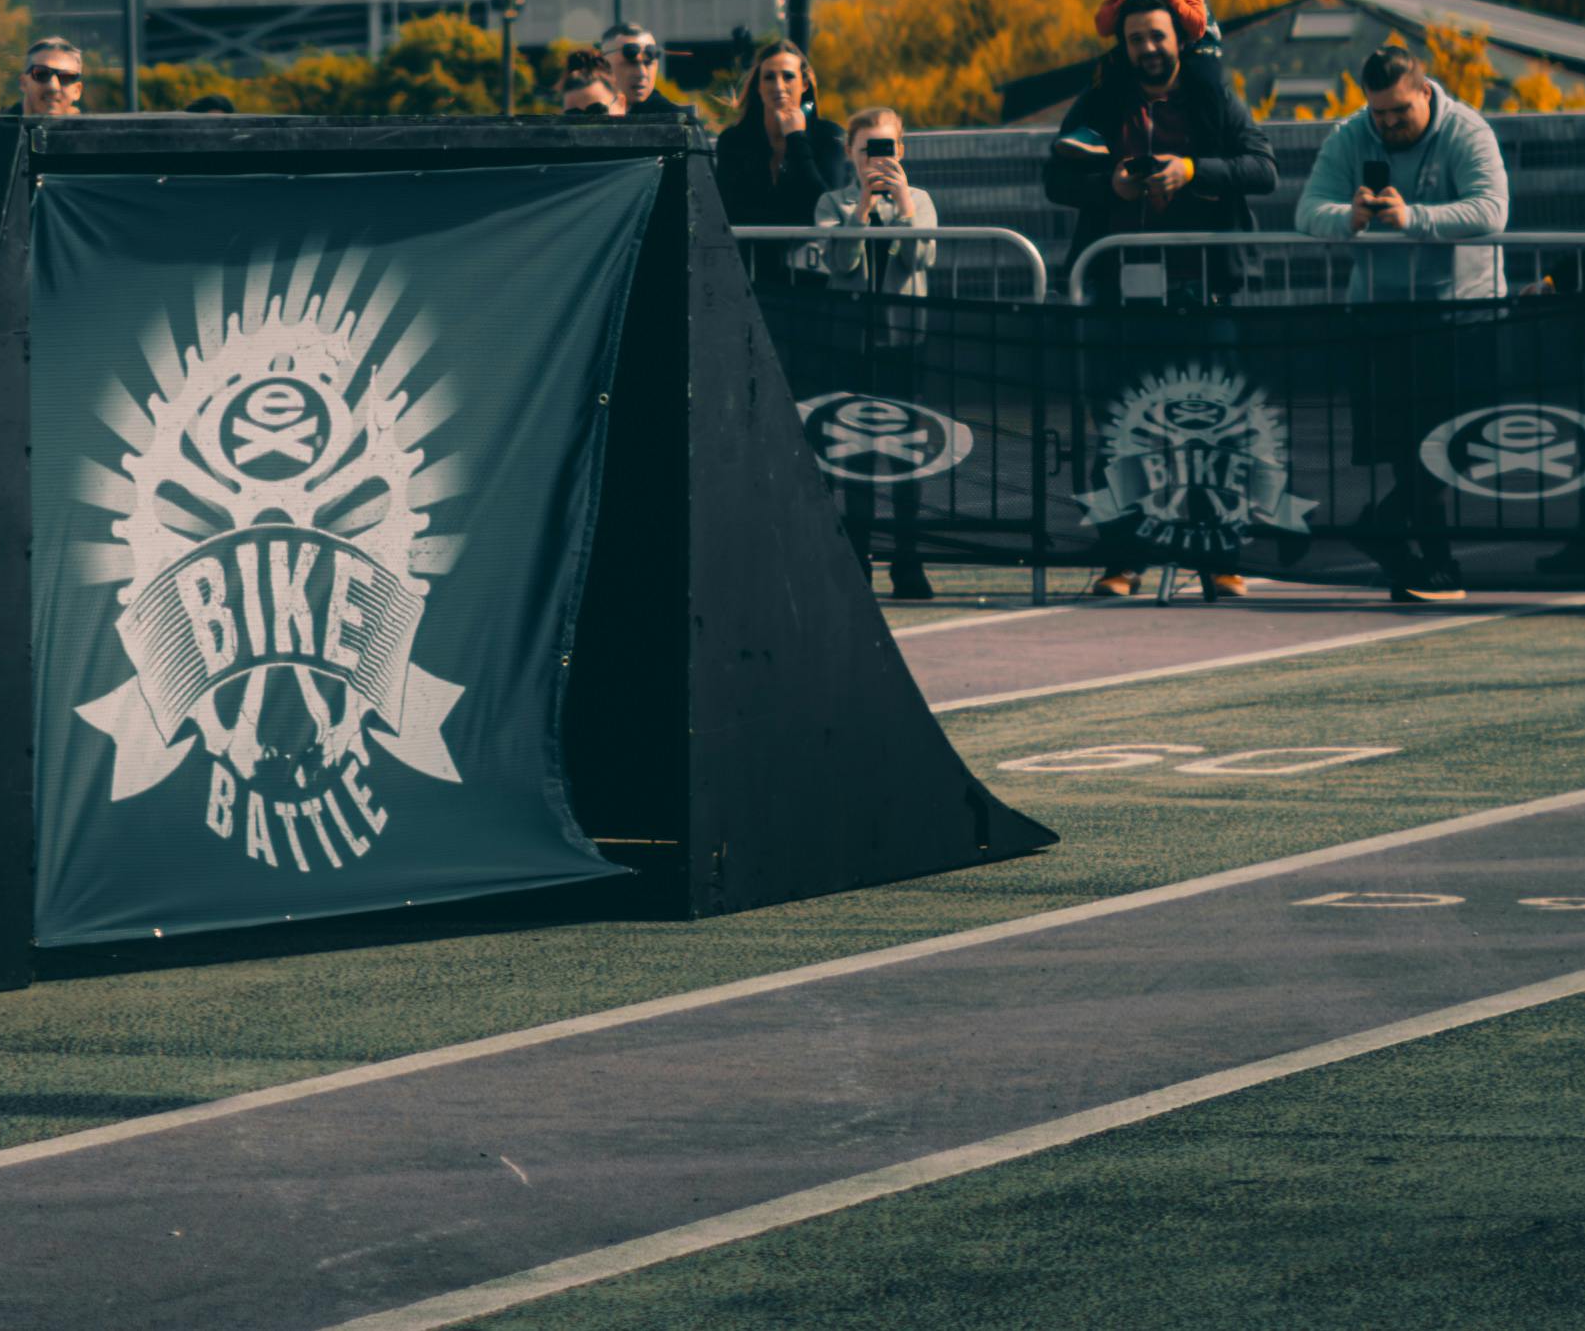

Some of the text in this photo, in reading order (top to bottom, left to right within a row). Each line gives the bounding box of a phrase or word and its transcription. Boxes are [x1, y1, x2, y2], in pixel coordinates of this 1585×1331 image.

[1140, 449, 1255, 493] BIKE
[1136, 516, 1254, 551] BATTLE
[175, 540, 374, 679] BIKE
[205, 758, 389, 872] BATTLE
